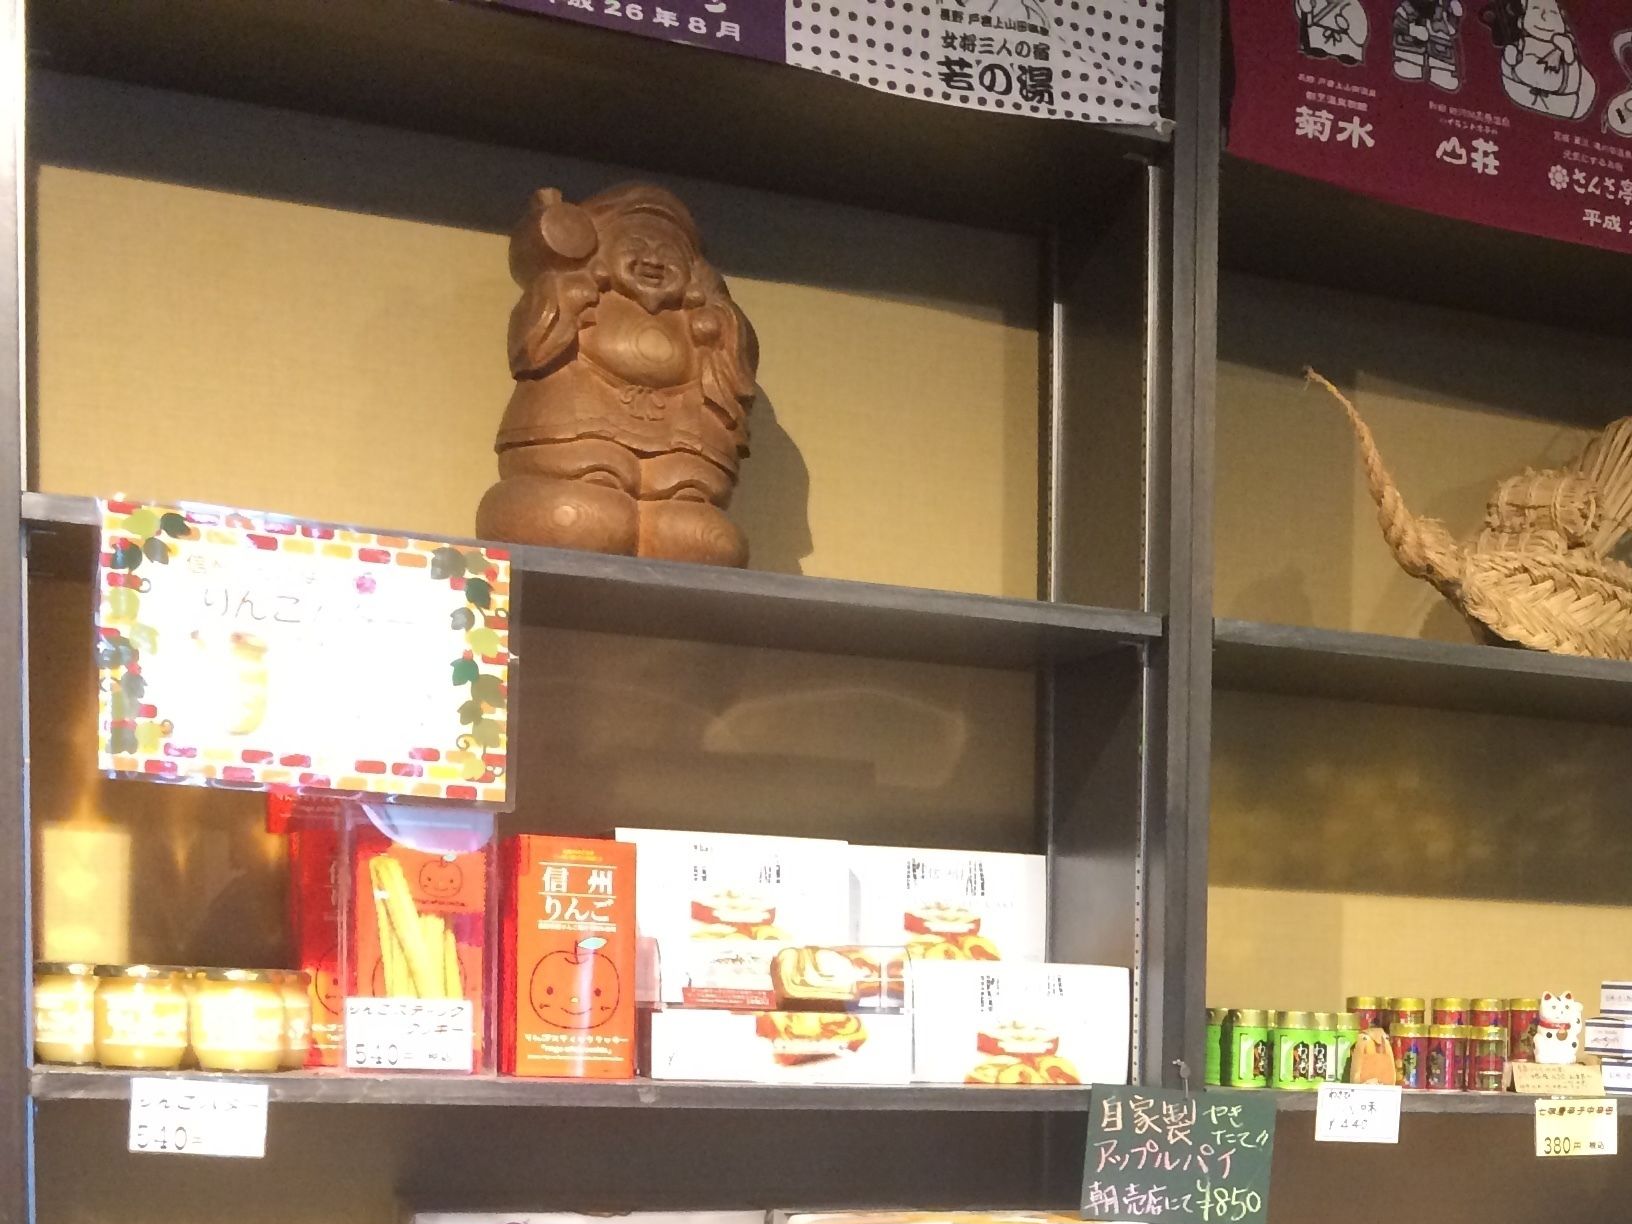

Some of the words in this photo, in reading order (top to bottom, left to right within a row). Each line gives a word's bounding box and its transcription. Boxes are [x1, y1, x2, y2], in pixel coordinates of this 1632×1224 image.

[1295, 105, 1375, 148] 菊水
[542, 866, 613, 895] 信州
[545, 896, 614, 922] りんご
[1101, 1094, 1197, 1146] 自家製
[1094, 1139, 1236, 1179] アップルパイ
